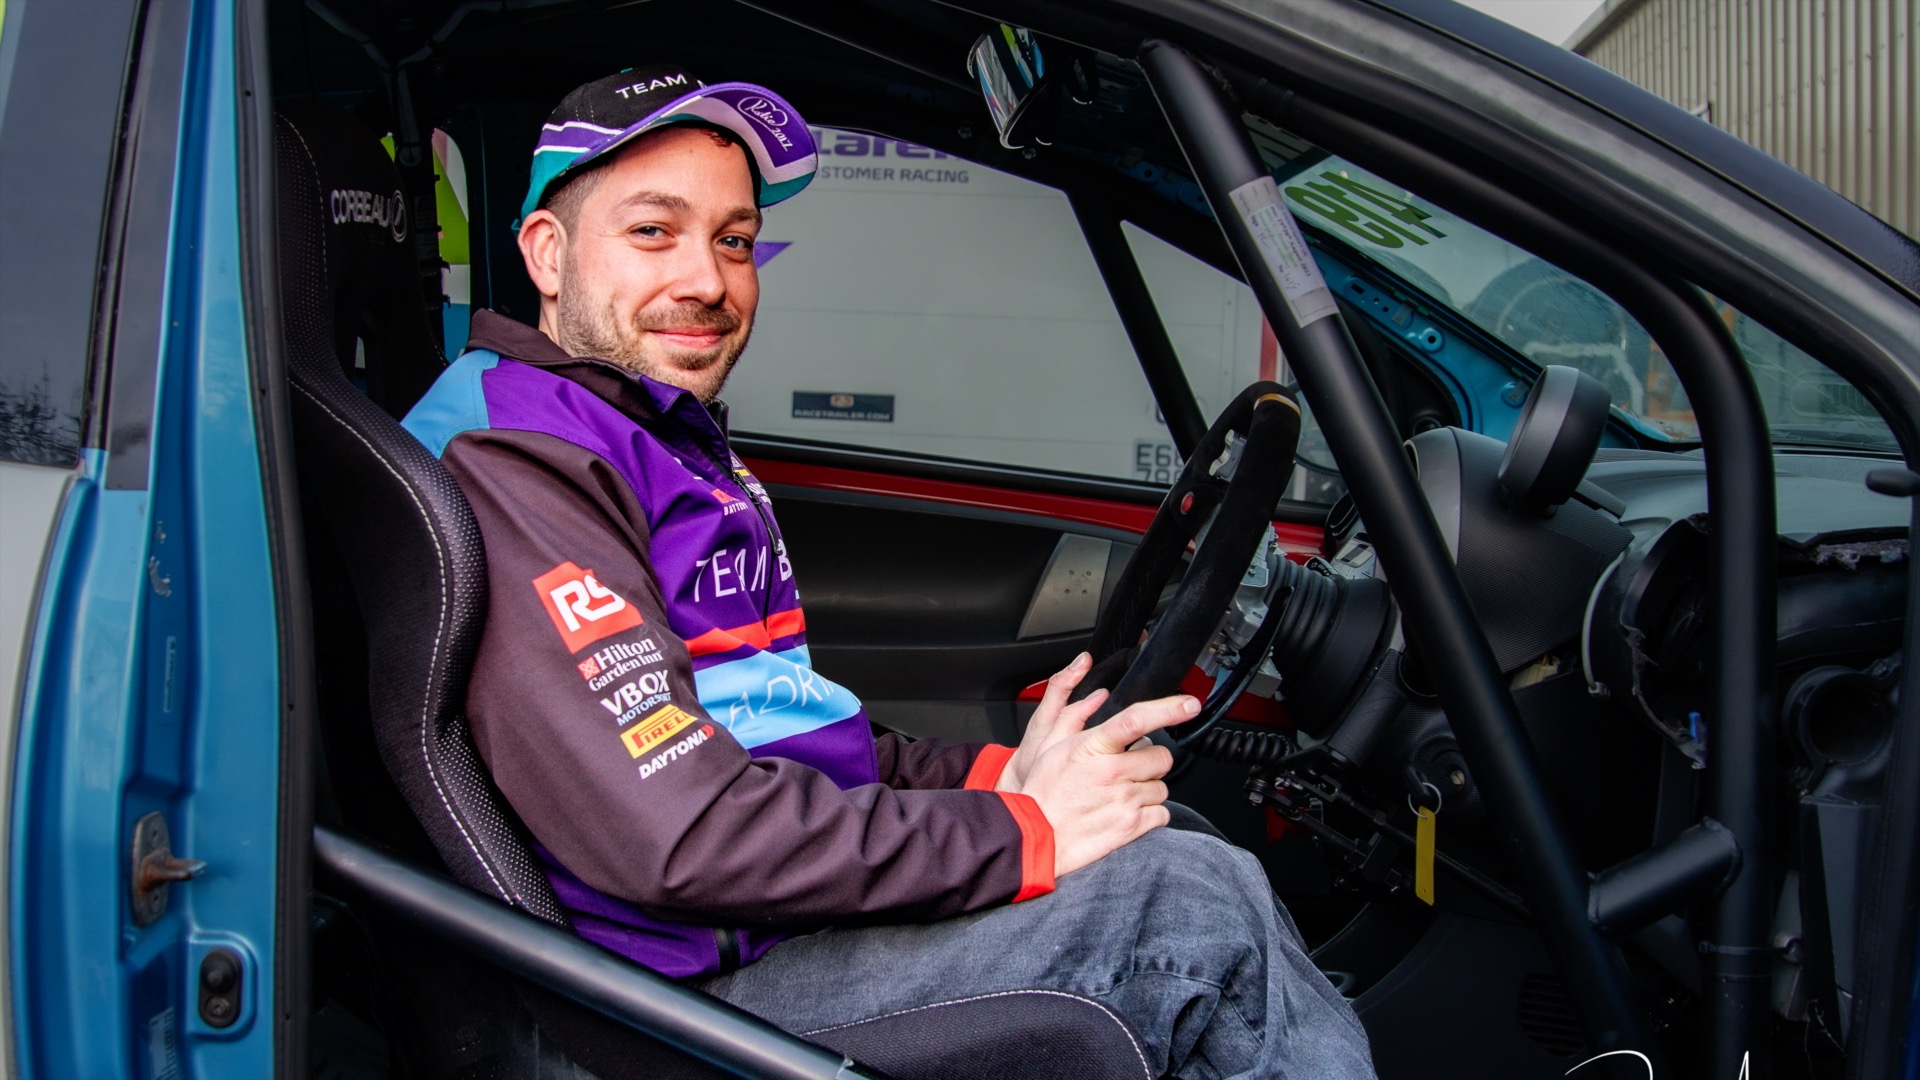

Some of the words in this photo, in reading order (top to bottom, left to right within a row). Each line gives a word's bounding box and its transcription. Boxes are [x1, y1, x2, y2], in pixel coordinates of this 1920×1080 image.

[615, 74, 688, 100] TEAM
[816, 166, 895, 181] STOMER
[901, 169, 970, 184] RACING
[331, 189, 391, 228] CORBEAU
[695, 546, 766, 602] TEAM
[550, 574, 626, 633] RS
[588, 659, 641, 692] Garden
[637, 651, 664, 666] Inn
[593, 638, 657, 671] Hilton
[600, 670, 670, 717] VBOX
[616, 692, 671, 727] MOTORSPORT
[631, 708, 690, 749] PIRELL
[638, 728, 708, 780] DAYTONA
